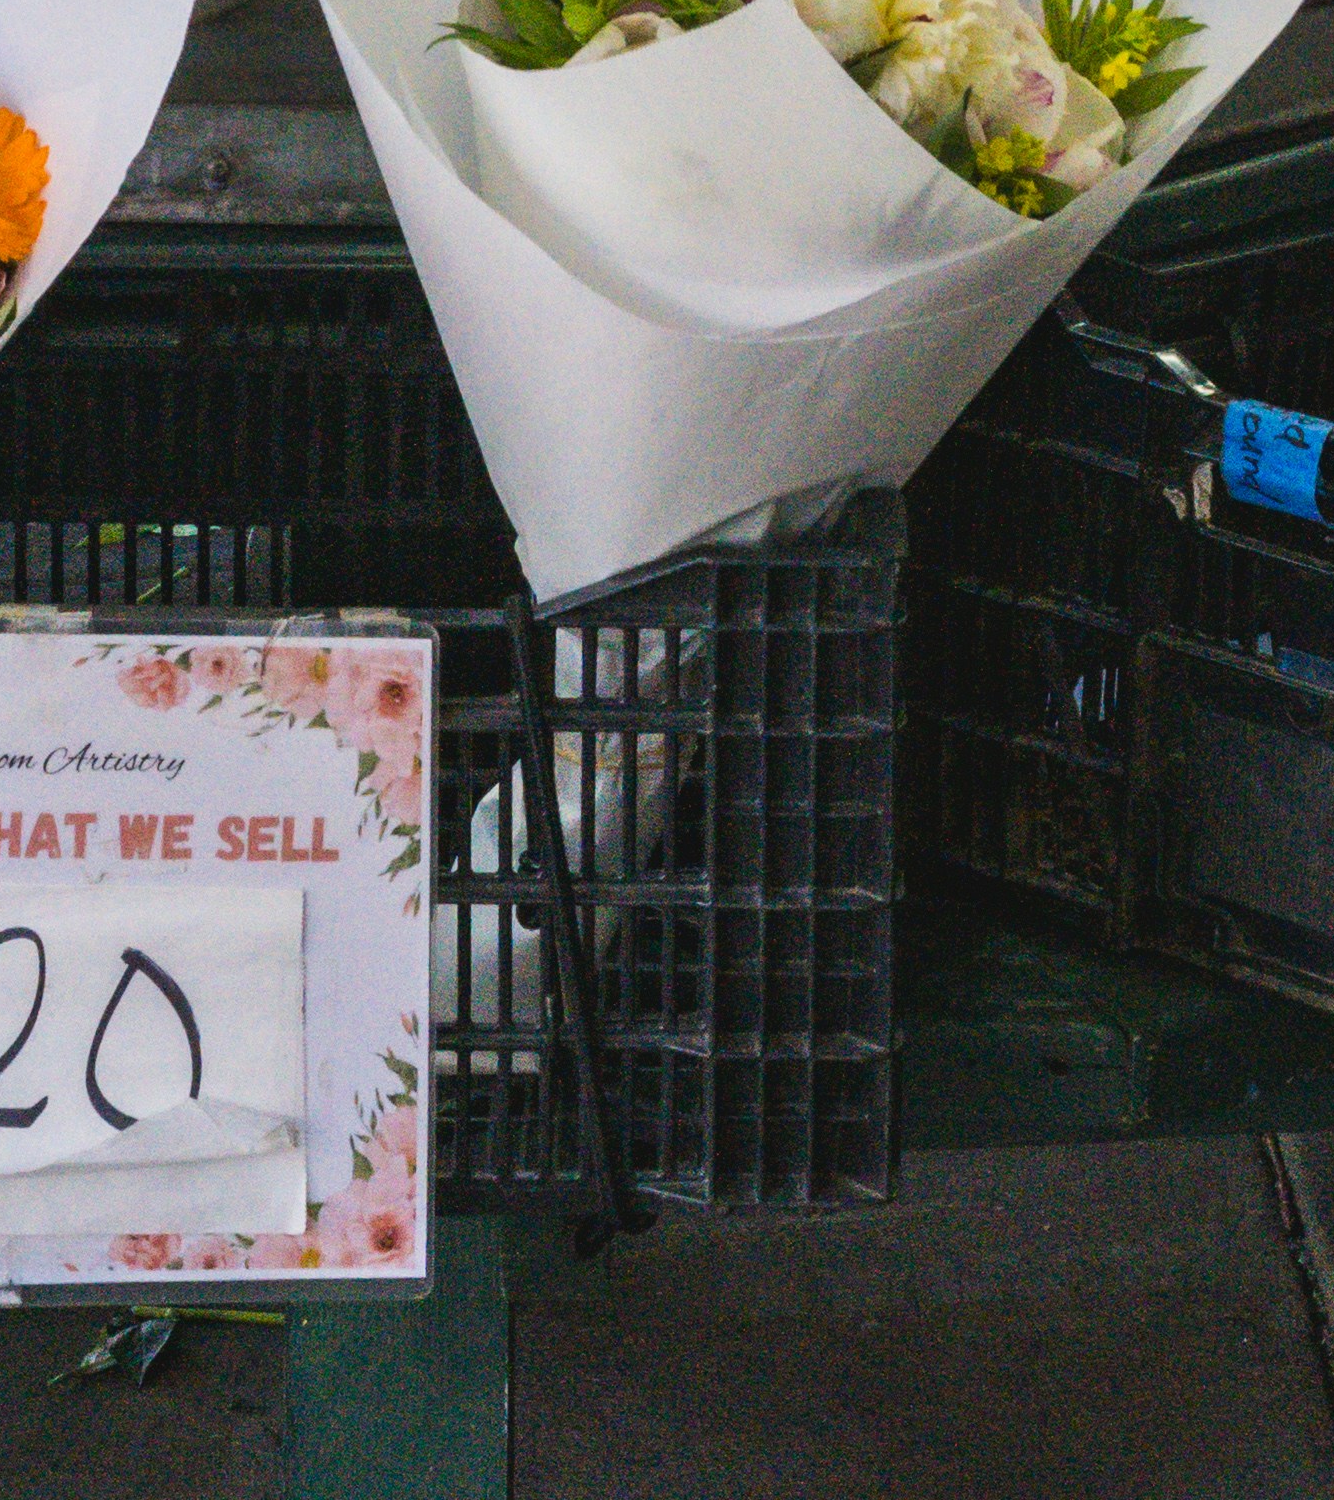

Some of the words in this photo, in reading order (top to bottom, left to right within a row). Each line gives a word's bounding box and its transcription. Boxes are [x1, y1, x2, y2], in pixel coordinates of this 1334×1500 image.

[42, 741, 187, 781] Artistry
[118, 814, 194, 861] WE
[215, 815, 339, 862] SELL
